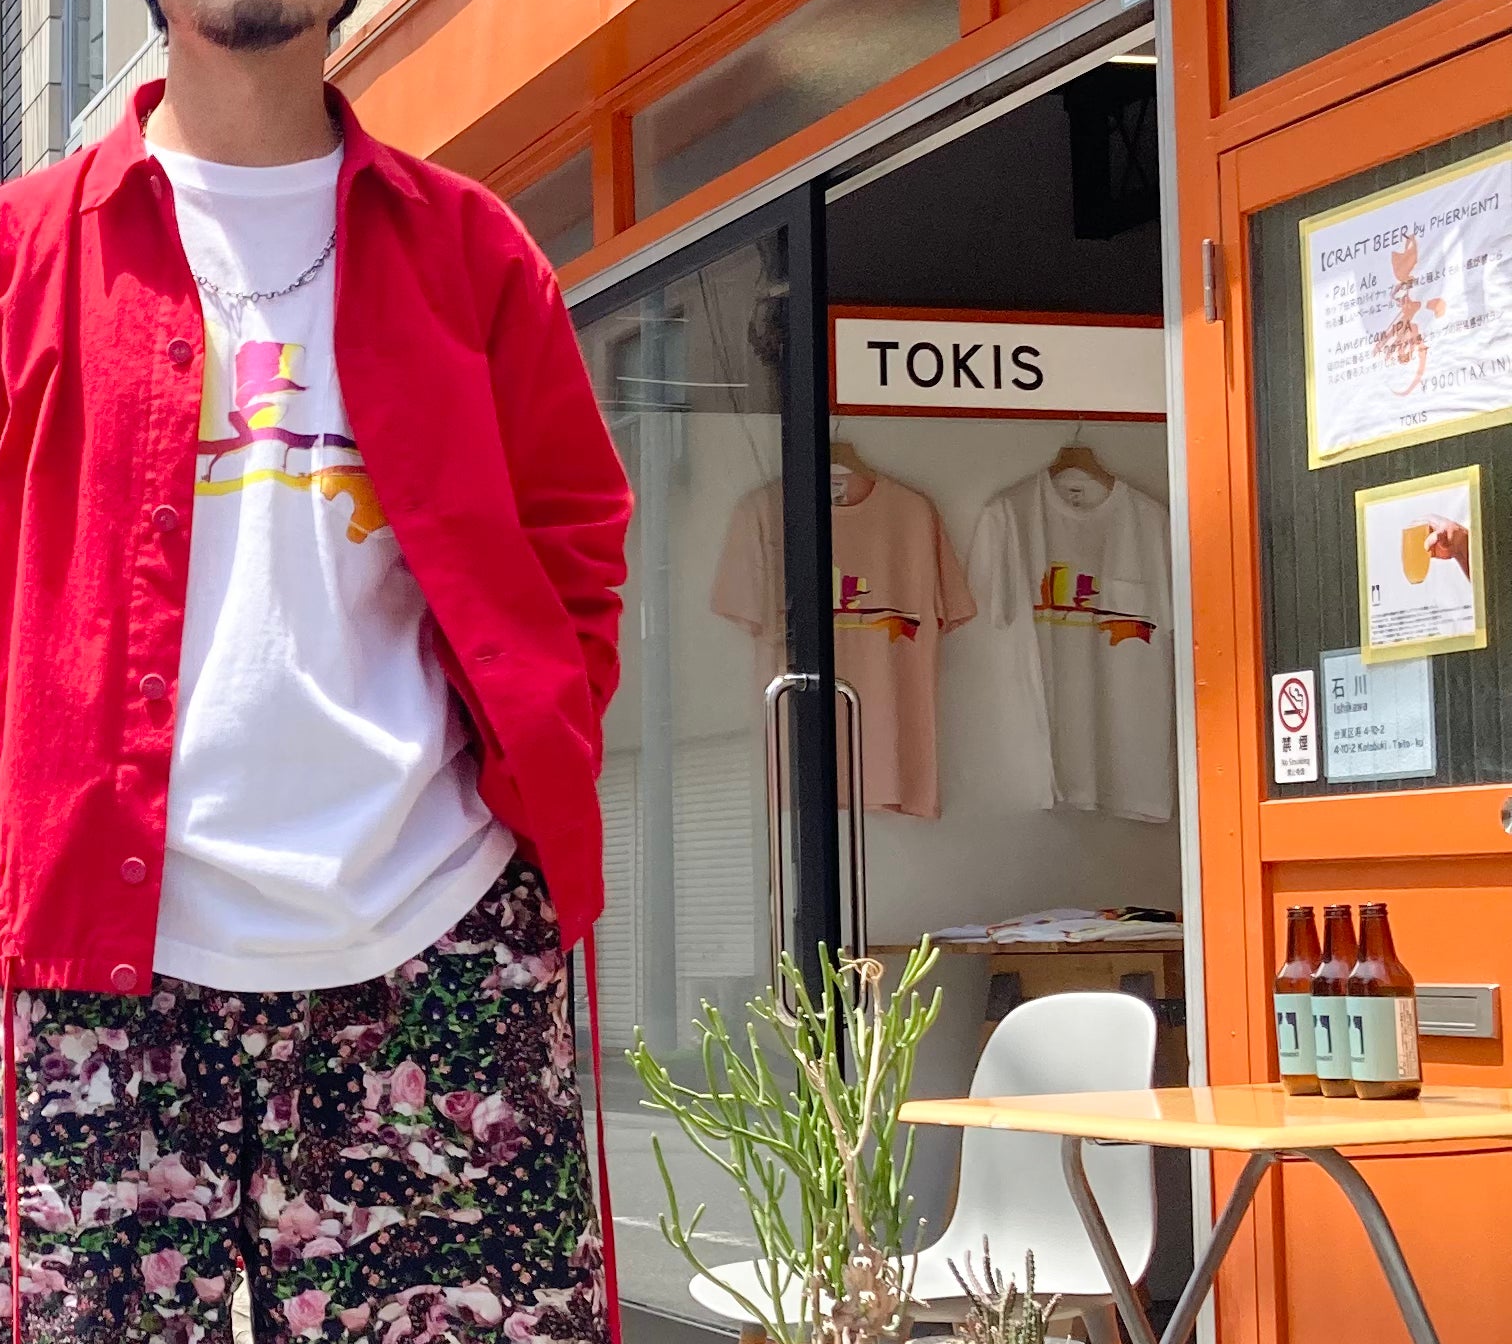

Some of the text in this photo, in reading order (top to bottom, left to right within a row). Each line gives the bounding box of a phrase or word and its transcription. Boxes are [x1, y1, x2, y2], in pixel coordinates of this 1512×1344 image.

[1373, 225, 1410, 252] BEER
[1413, 222, 1426, 237] by
[1360, 273, 1377, 290] Ale
[1392, 320, 1412, 335] IPA
[866, 341, 1044, 391] TOKIS
[1400, 410, 1427, 426] TOKIS
